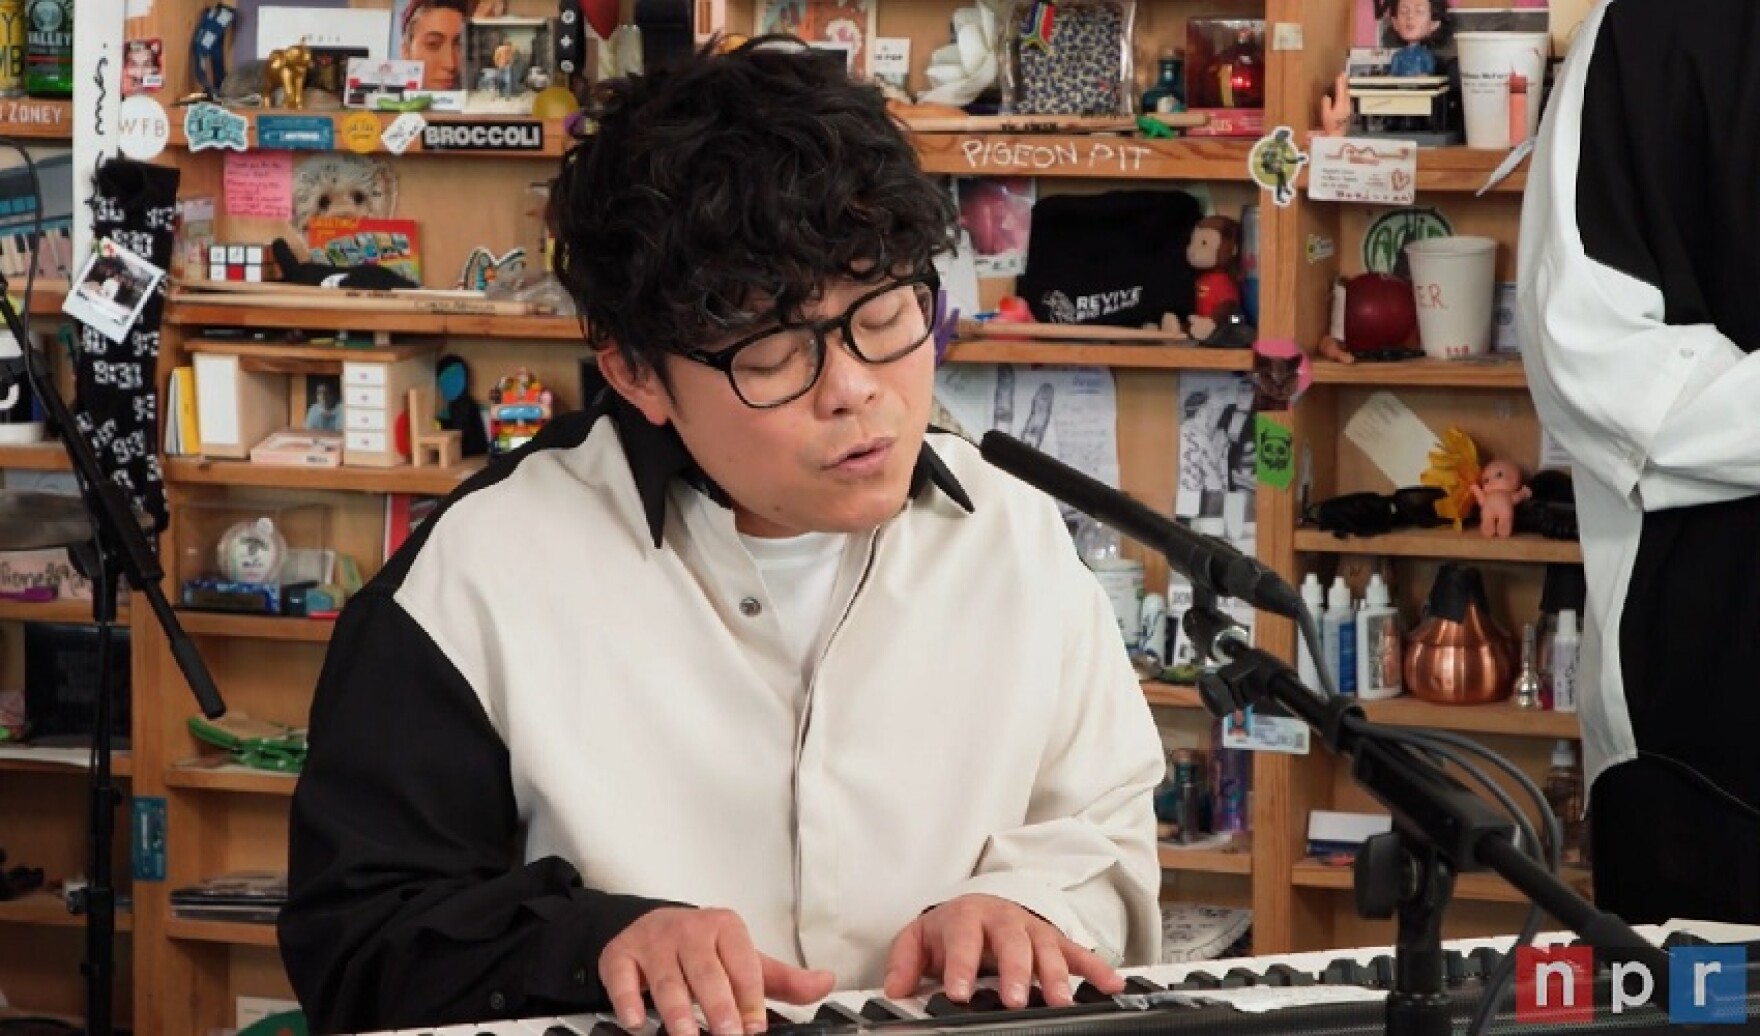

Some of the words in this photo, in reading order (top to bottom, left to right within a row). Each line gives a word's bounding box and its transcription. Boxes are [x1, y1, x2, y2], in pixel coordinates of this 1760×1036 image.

[424, 126, 540, 147] BROCCOLI
[962, 140, 1078, 168] PIGEON
[1089, 143, 1152, 171] PIT
[1076, 286, 1143, 315] REVIVE
